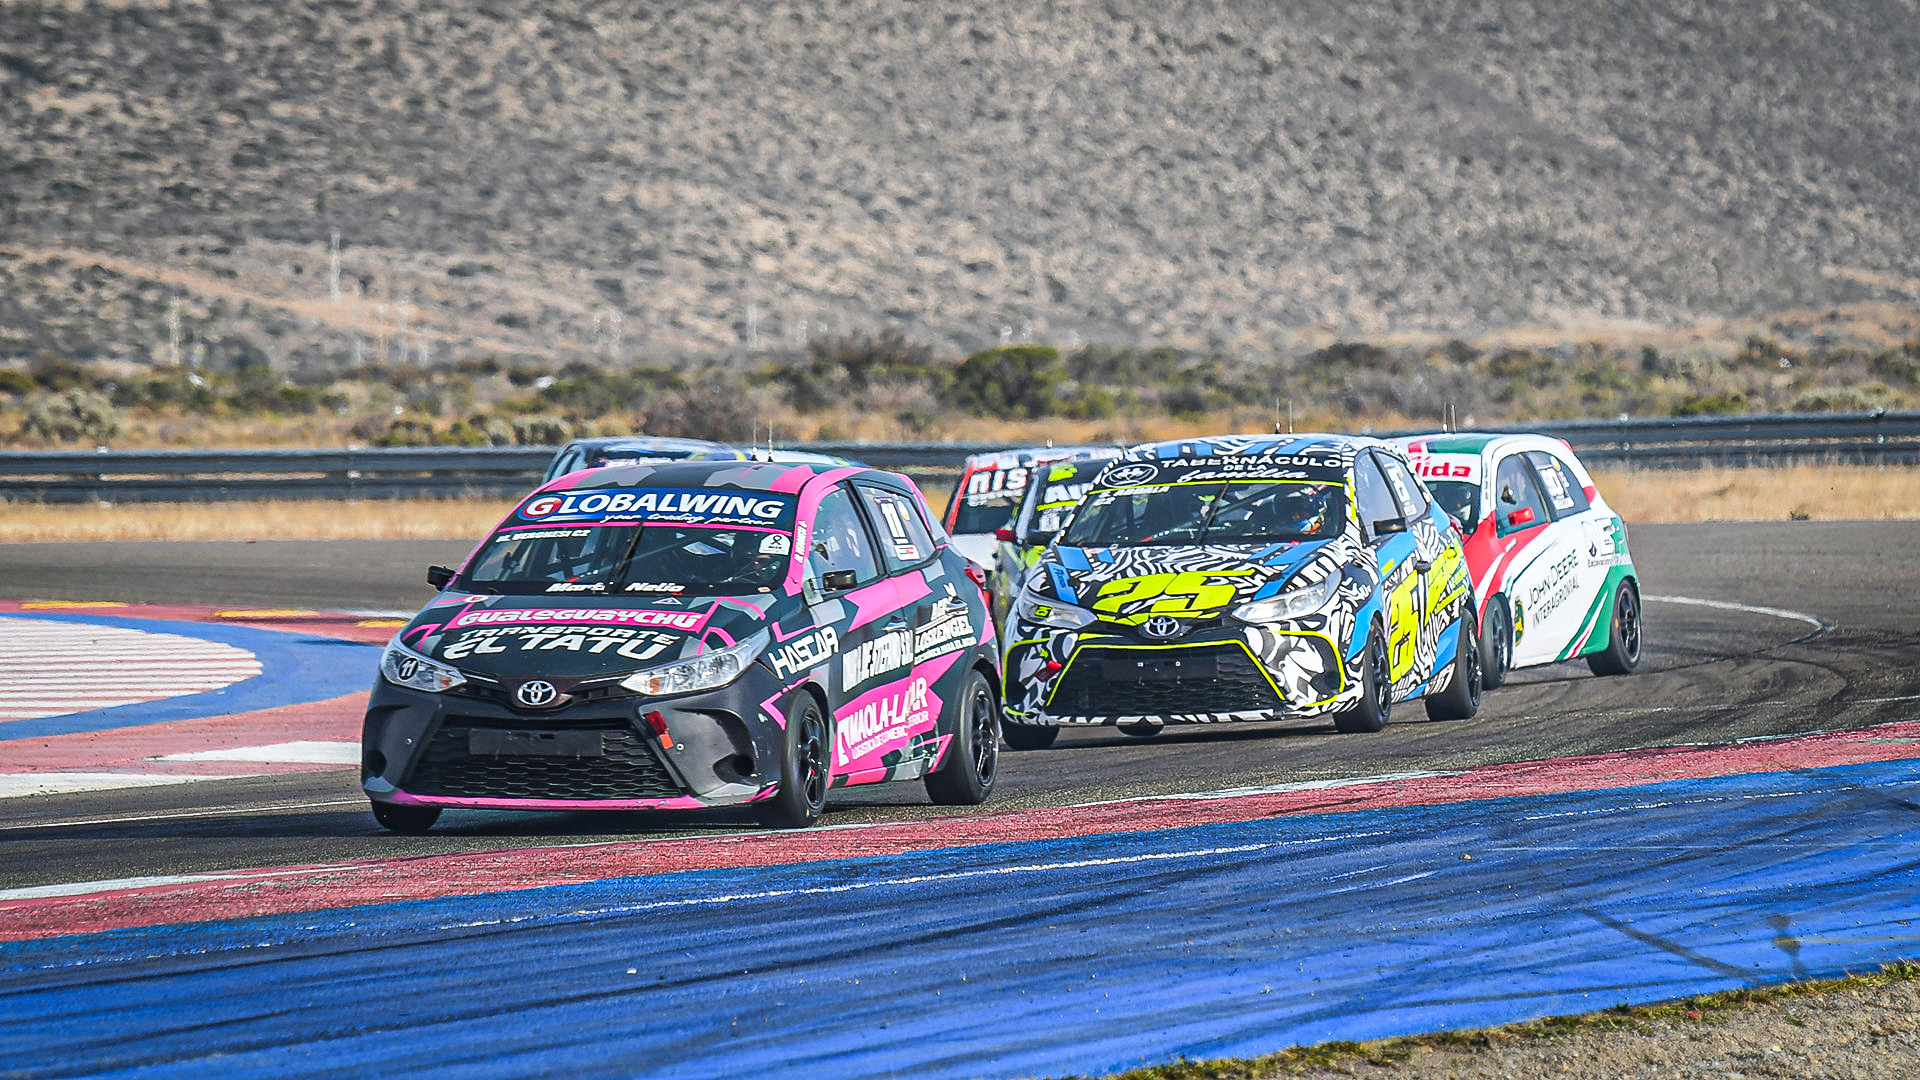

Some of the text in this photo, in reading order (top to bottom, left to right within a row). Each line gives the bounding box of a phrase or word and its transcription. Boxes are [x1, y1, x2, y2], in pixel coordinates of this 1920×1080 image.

[525, 493, 785, 519] GLOBALWING
[600, 514, 642, 524] your
[1528, 549, 1579, 611] JOHN DEERE
[1092, 569, 1255, 626] 25
[459, 626, 681, 646] TRANSPORTE
[443, 637, 506, 660] EL
